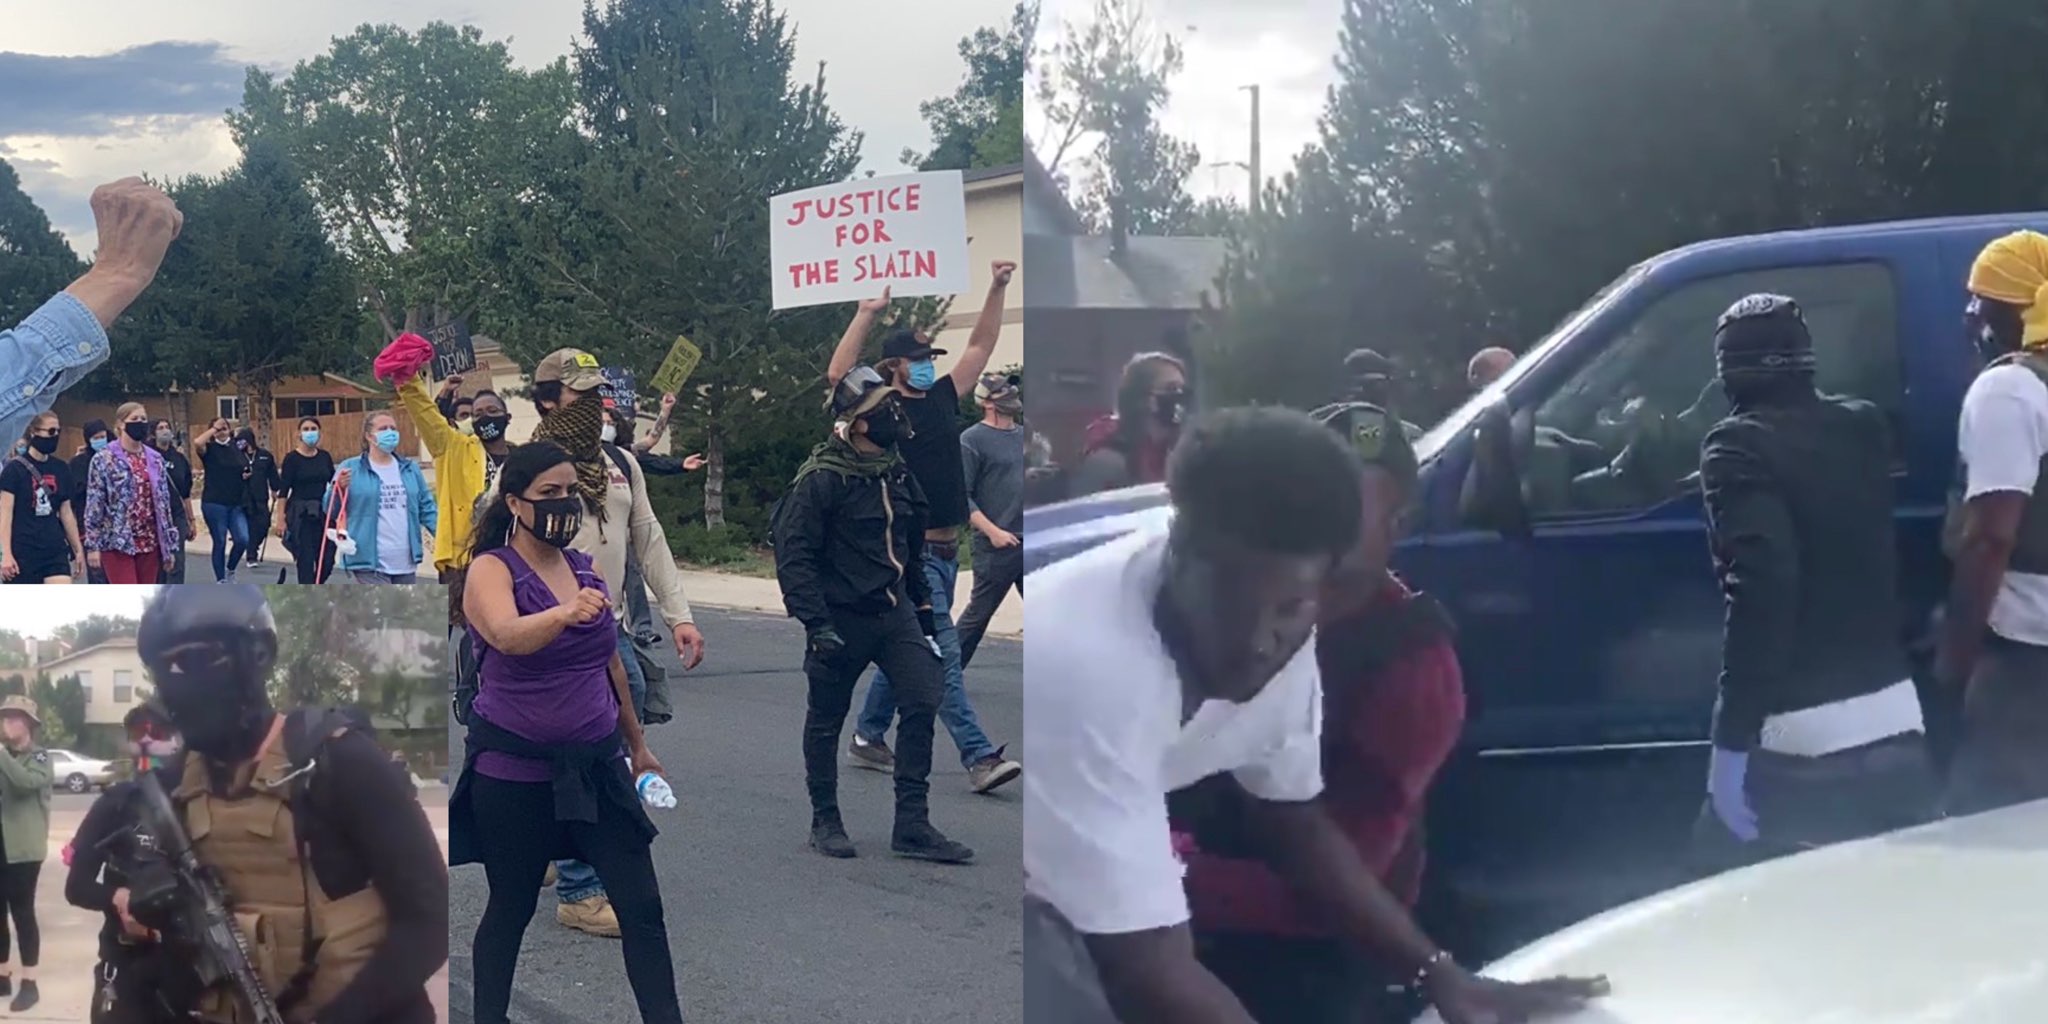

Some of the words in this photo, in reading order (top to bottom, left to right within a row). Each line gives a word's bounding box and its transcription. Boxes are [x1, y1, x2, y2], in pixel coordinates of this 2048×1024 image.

[787, 184, 921, 226] JUSTICE
[835, 219, 893, 247] FOR
[788, 259, 839, 289] THE
[853, 250, 937, 282] SLAIN
